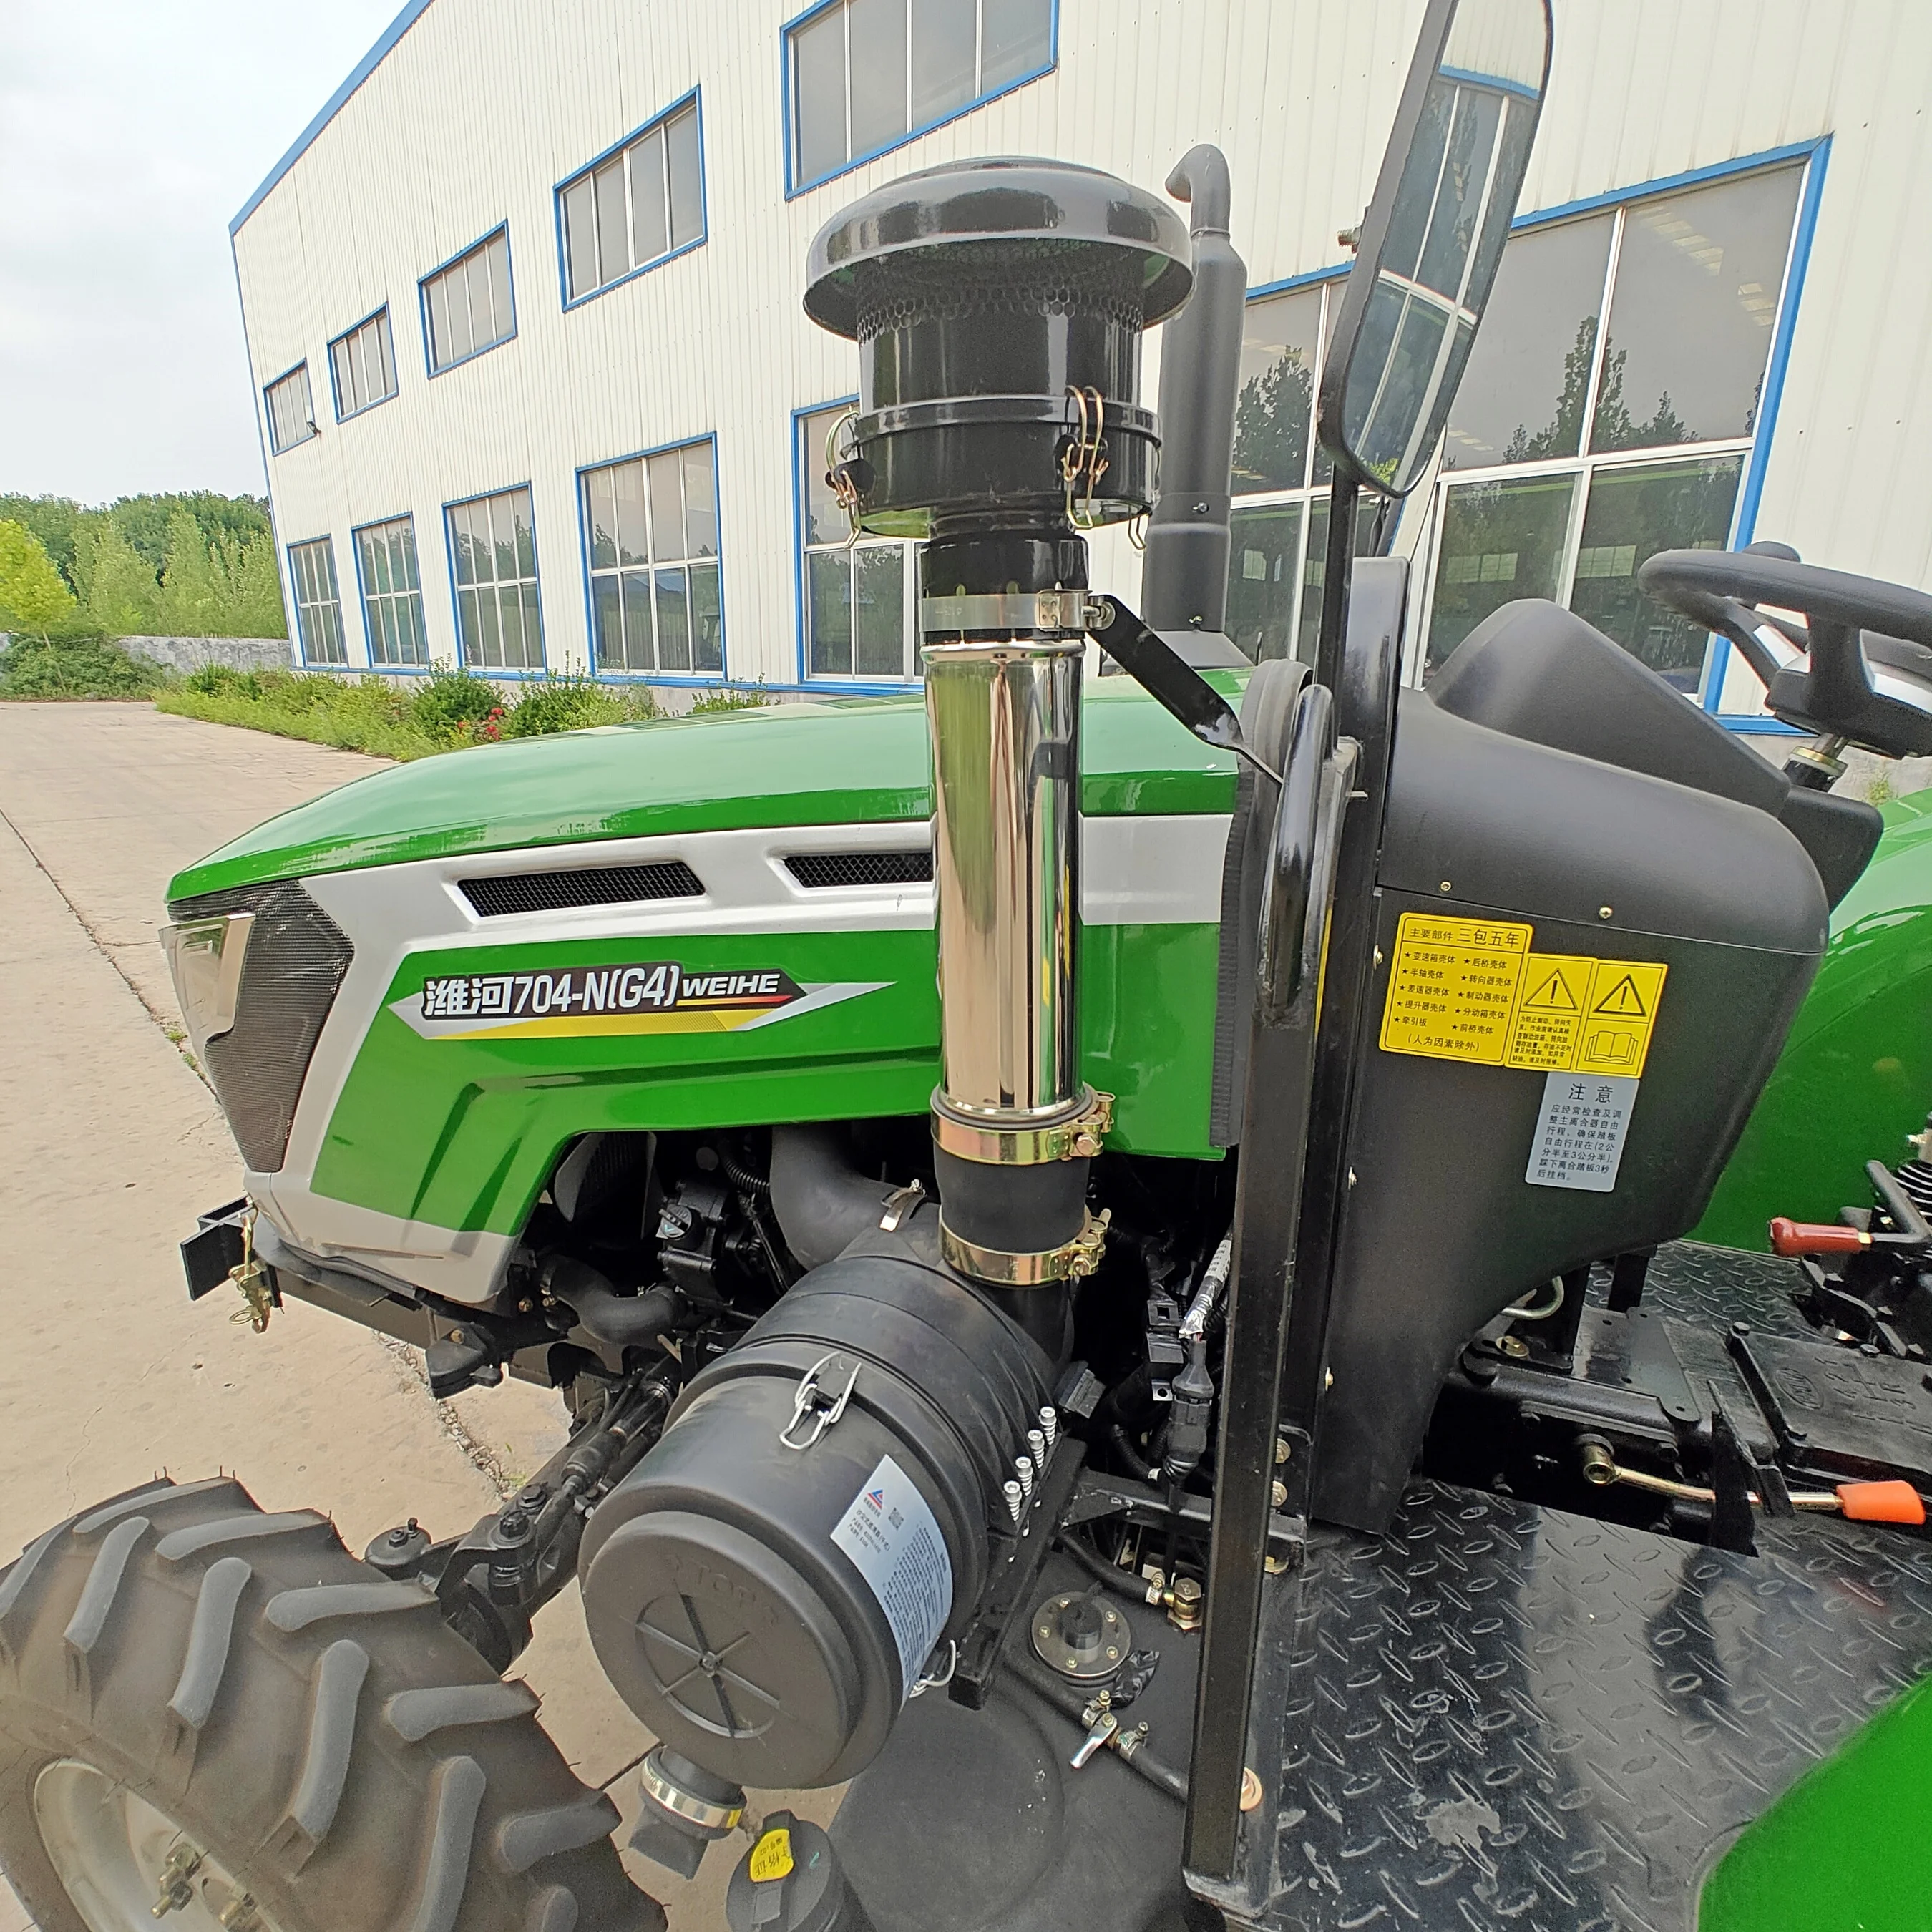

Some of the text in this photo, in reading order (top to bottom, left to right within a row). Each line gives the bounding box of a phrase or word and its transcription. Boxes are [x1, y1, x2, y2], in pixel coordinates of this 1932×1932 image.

[1409, 927, 1520, 949] 主要部件 三包五年
[1413, 952, 1456, 964] 变速箱壳体
[1471, 958, 1508, 970] 后桥壳体
[1410, 967, 1445, 980] 半轴壳体
[683, 974, 780, 997] WEIHE
[1469, 975, 1513, 987] 转向器壳体
[1407, 984, 1450, 997] 差速器壳体
[1466, 991, 1510, 1003] 制动器壳体
[1405, 1000, 1448, 1013] 提升器壳体
[1463, 1007, 1506, 1020] 分动箱壳体
[1402, 1016, 1428, 1027] 牵引板
[1459, 1023, 1495, 1035] 前桥壳体
[1568, 1083, 1614, 1103] 注意
[1551, 1104, 1622, 1119] 应经常检查及调
[1548, 1115, 1619, 1130] 整主离合器自由
